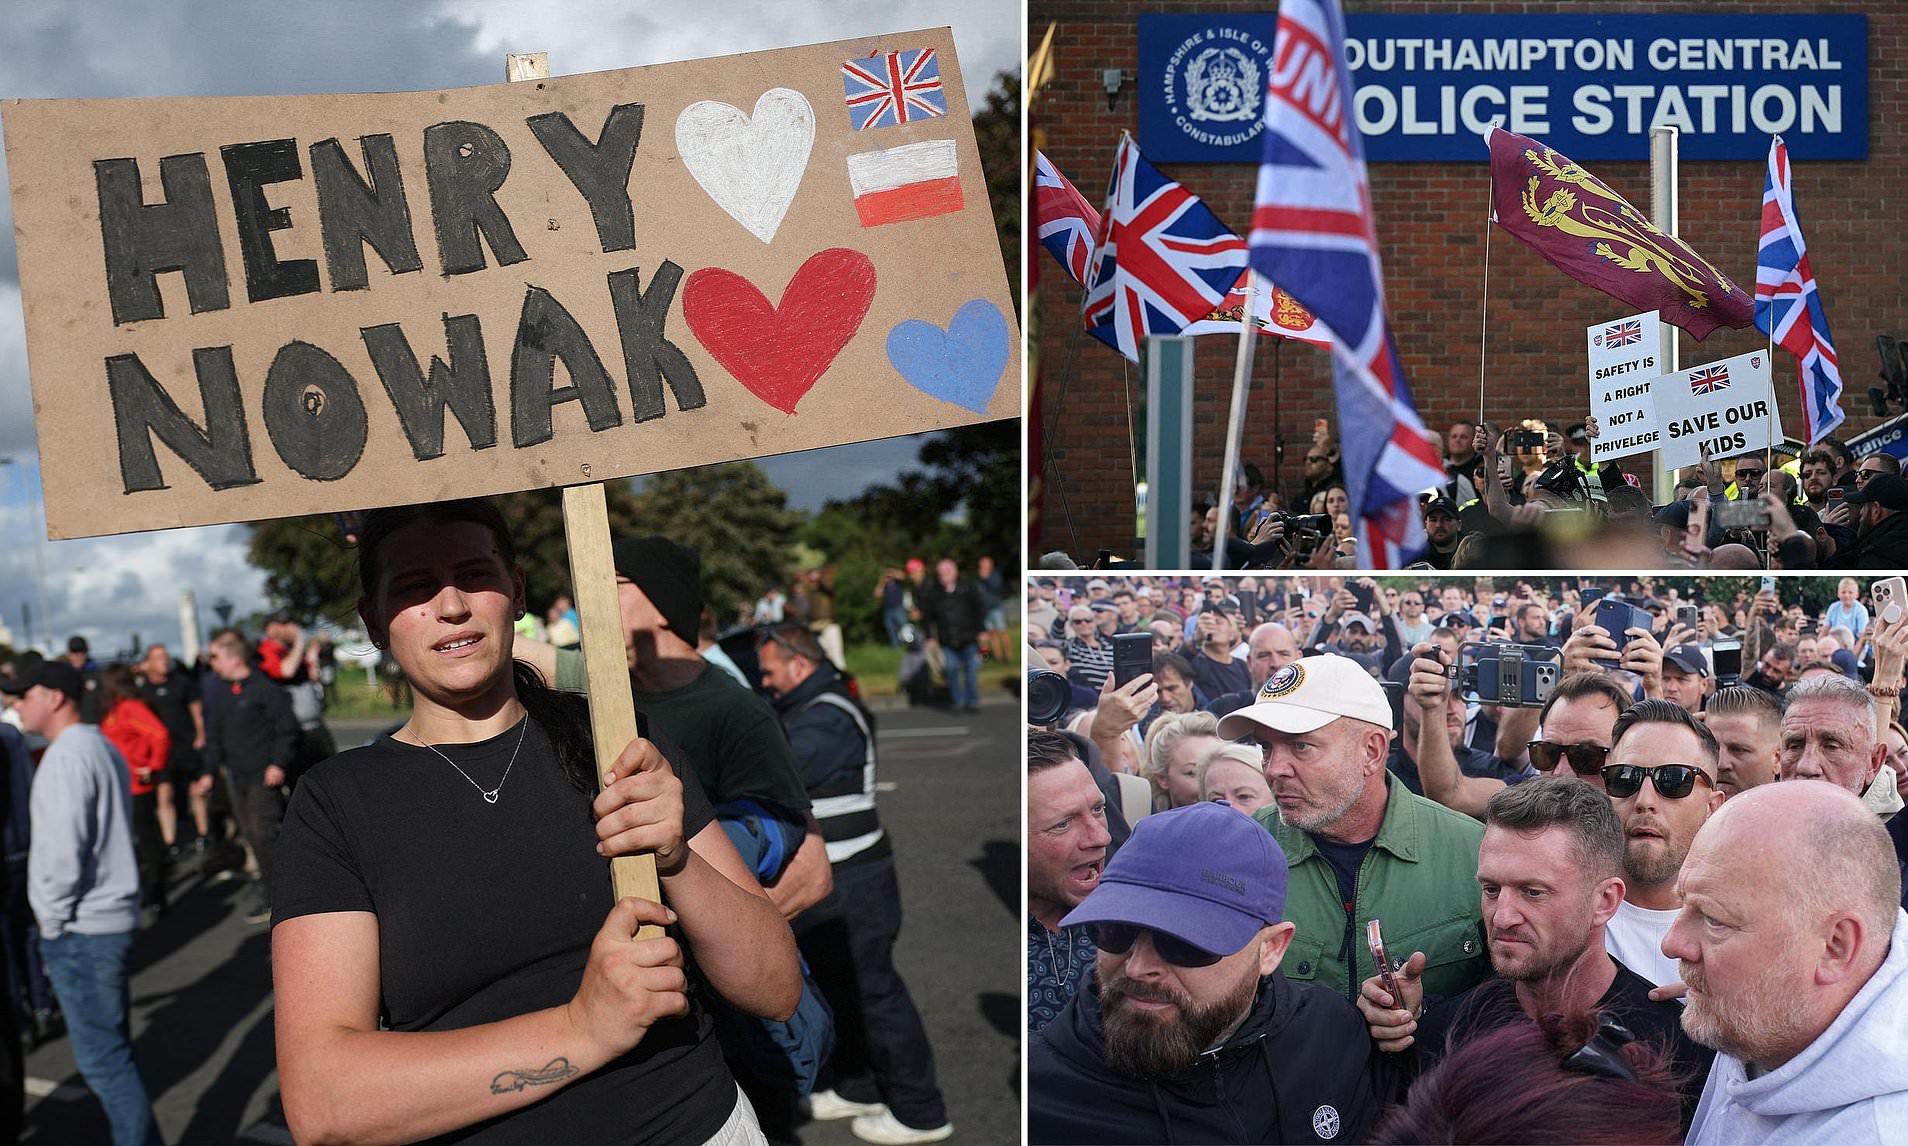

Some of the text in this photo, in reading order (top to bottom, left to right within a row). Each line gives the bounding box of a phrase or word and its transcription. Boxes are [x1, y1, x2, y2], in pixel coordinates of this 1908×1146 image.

[1163, 27, 1268, 104] HAMPSHIRE & ISLE OF
[1343, 38, 1842, 71] OUTHAMPTON CENTRAL
[1269, 27, 1344, 132] UNI
[1353, 84, 1842, 136] OLICE STATION
[93, 101, 646, 327] HENRY
[105, 258, 708, 496] NOWAK
[1595, 356, 1654, 380] SAFETY IS
[1604, 382, 1651, 403] A RIGHT
[1609, 409, 1644, 427] NOT A
[1668, 400, 1769, 439] SAVE OUR
[1594, 430, 1660, 455] PRIVELEGE
[1699, 432, 1746, 458] KIDS
